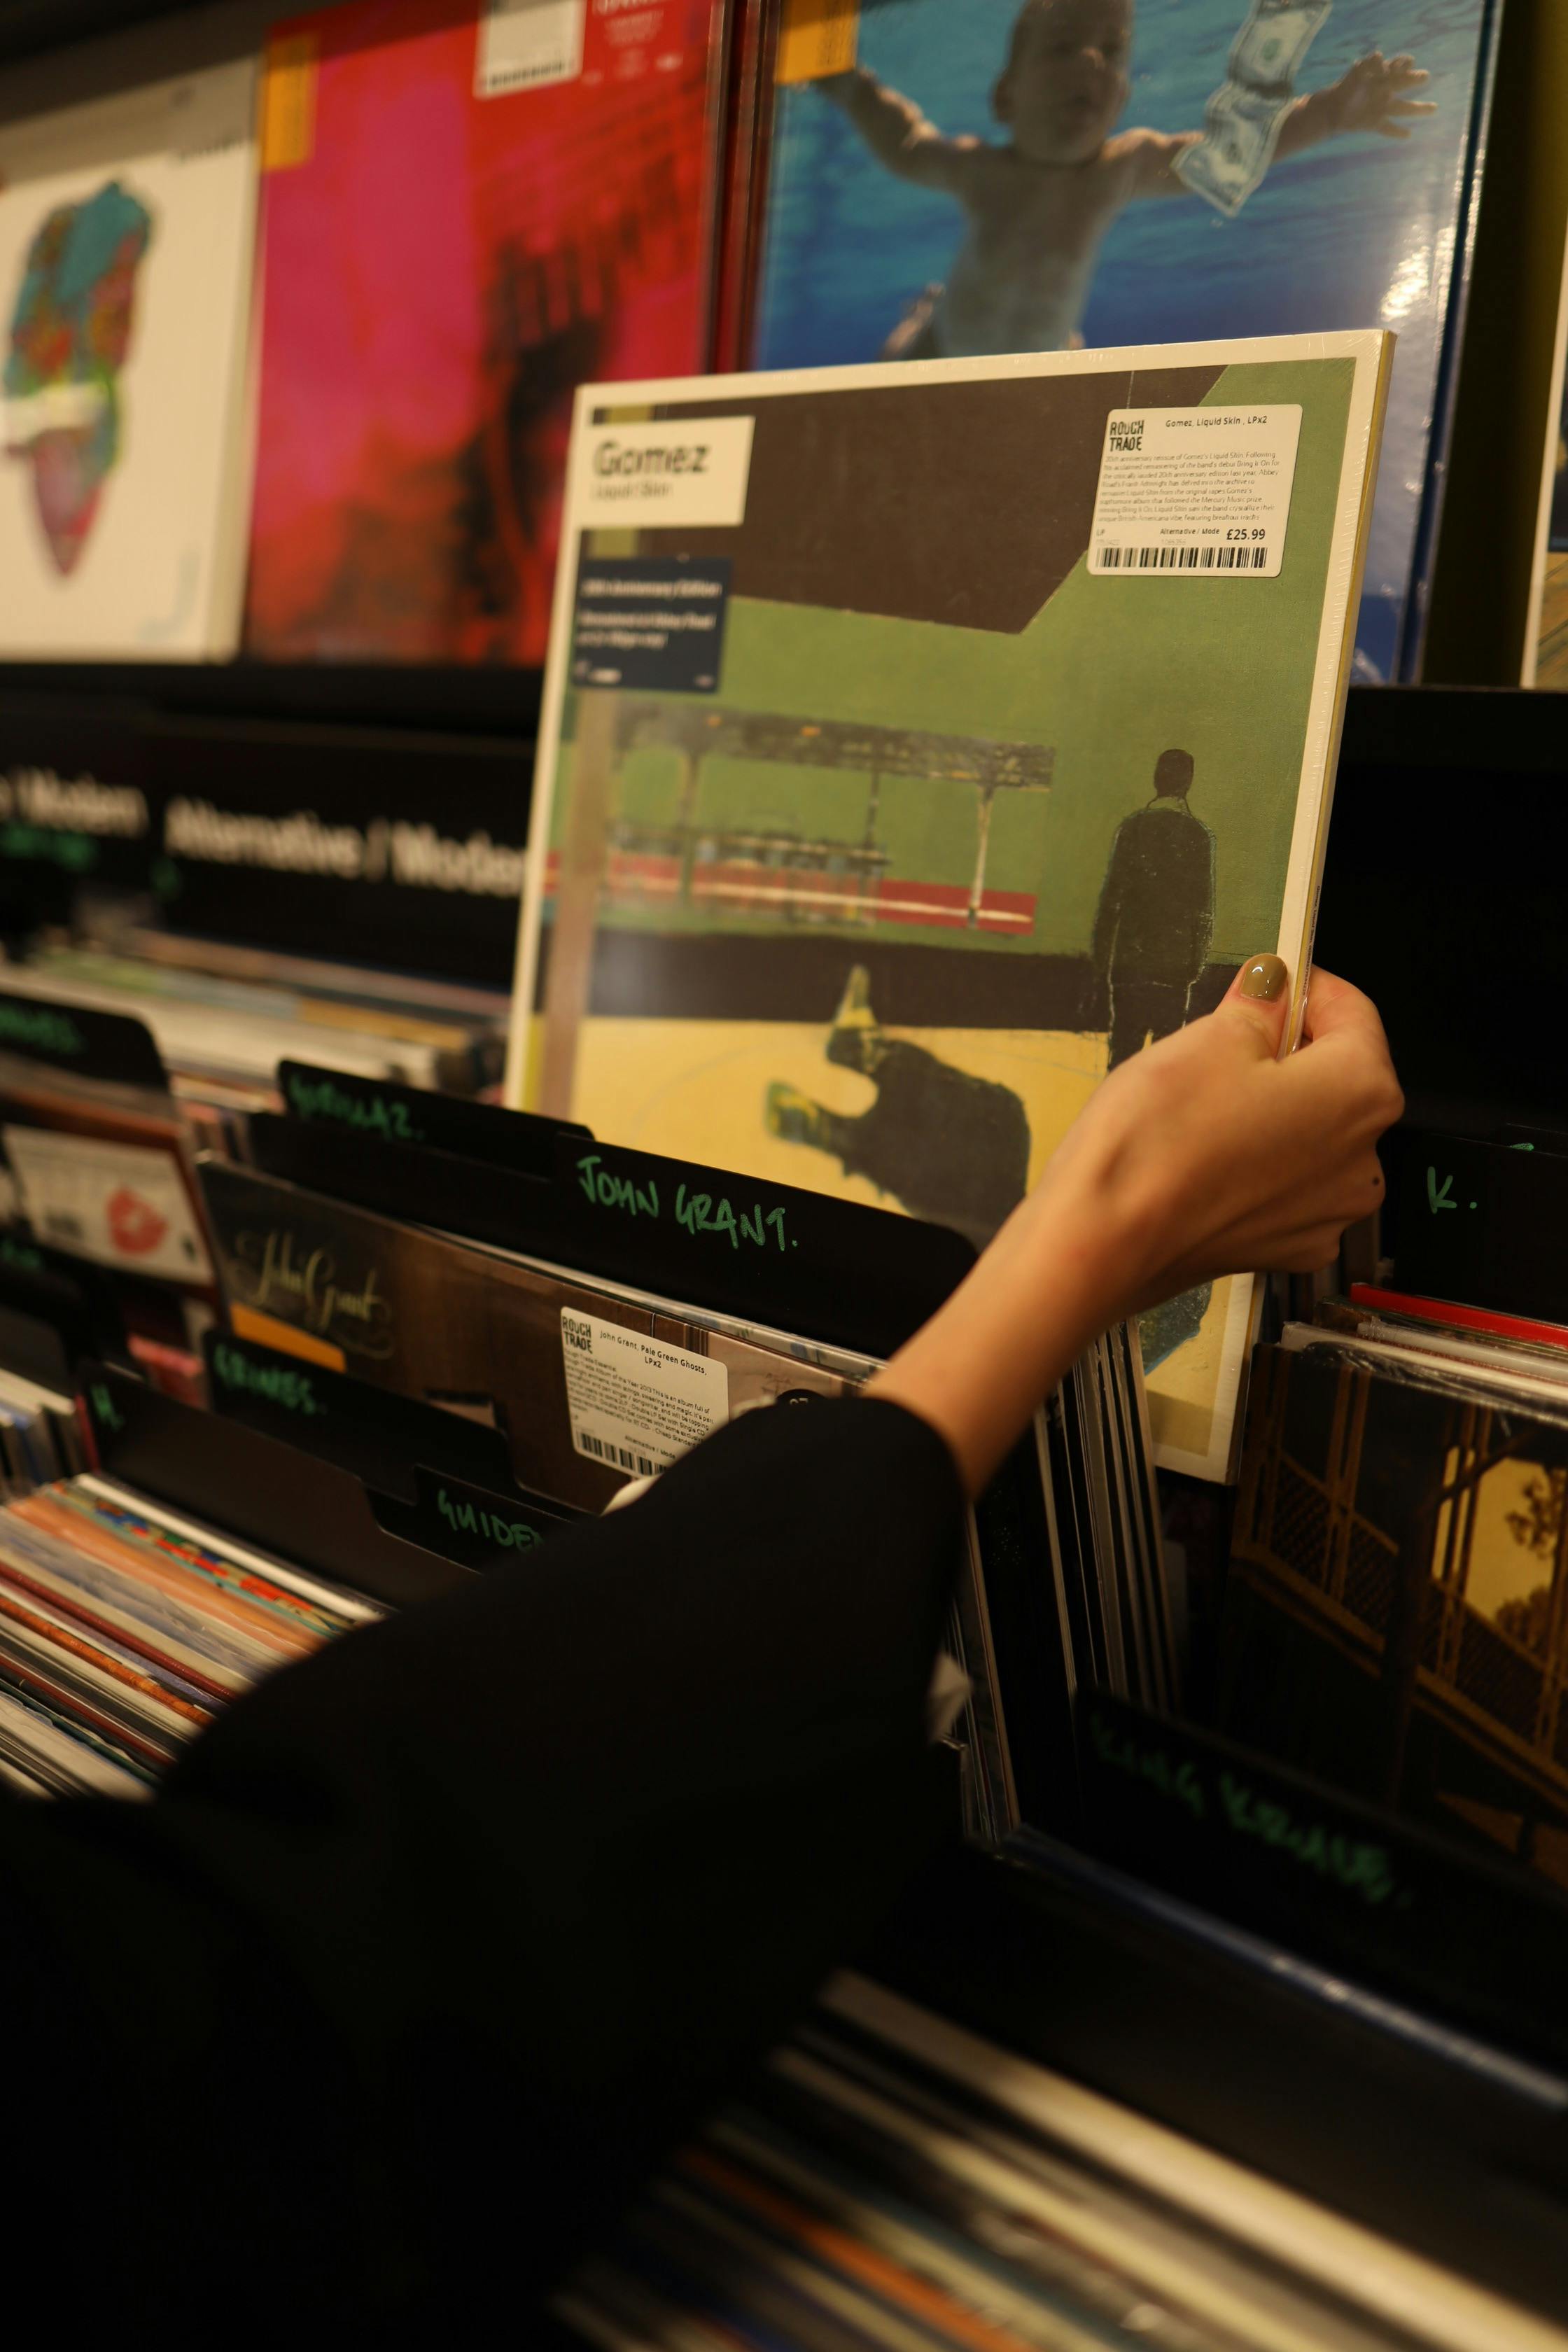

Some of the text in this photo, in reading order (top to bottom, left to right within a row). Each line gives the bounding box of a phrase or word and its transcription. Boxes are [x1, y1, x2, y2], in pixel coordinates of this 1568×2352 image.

[1110, 420, 1144, 435] ROUGH
[1196, 418, 1221, 427] Liquid
[1108, 437, 1142, 451] TRADE
[594, 440, 710, 477] Gomez
[1226, 528, 1265, 540] £25.99
[164, 792, 363, 881] Alternative
[1426, 1165, 1478, 1215] K.
[576, 1155, 799, 1252] JOHN GRANT.
[562, 1315, 591, 1338] ROUGH
[564, 1331, 592, 1354] TRADE
[600, 1331, 706, 1376] John Grant, Pale Green Ghosts,
[645, 1356, 661, 1368] LPx2
